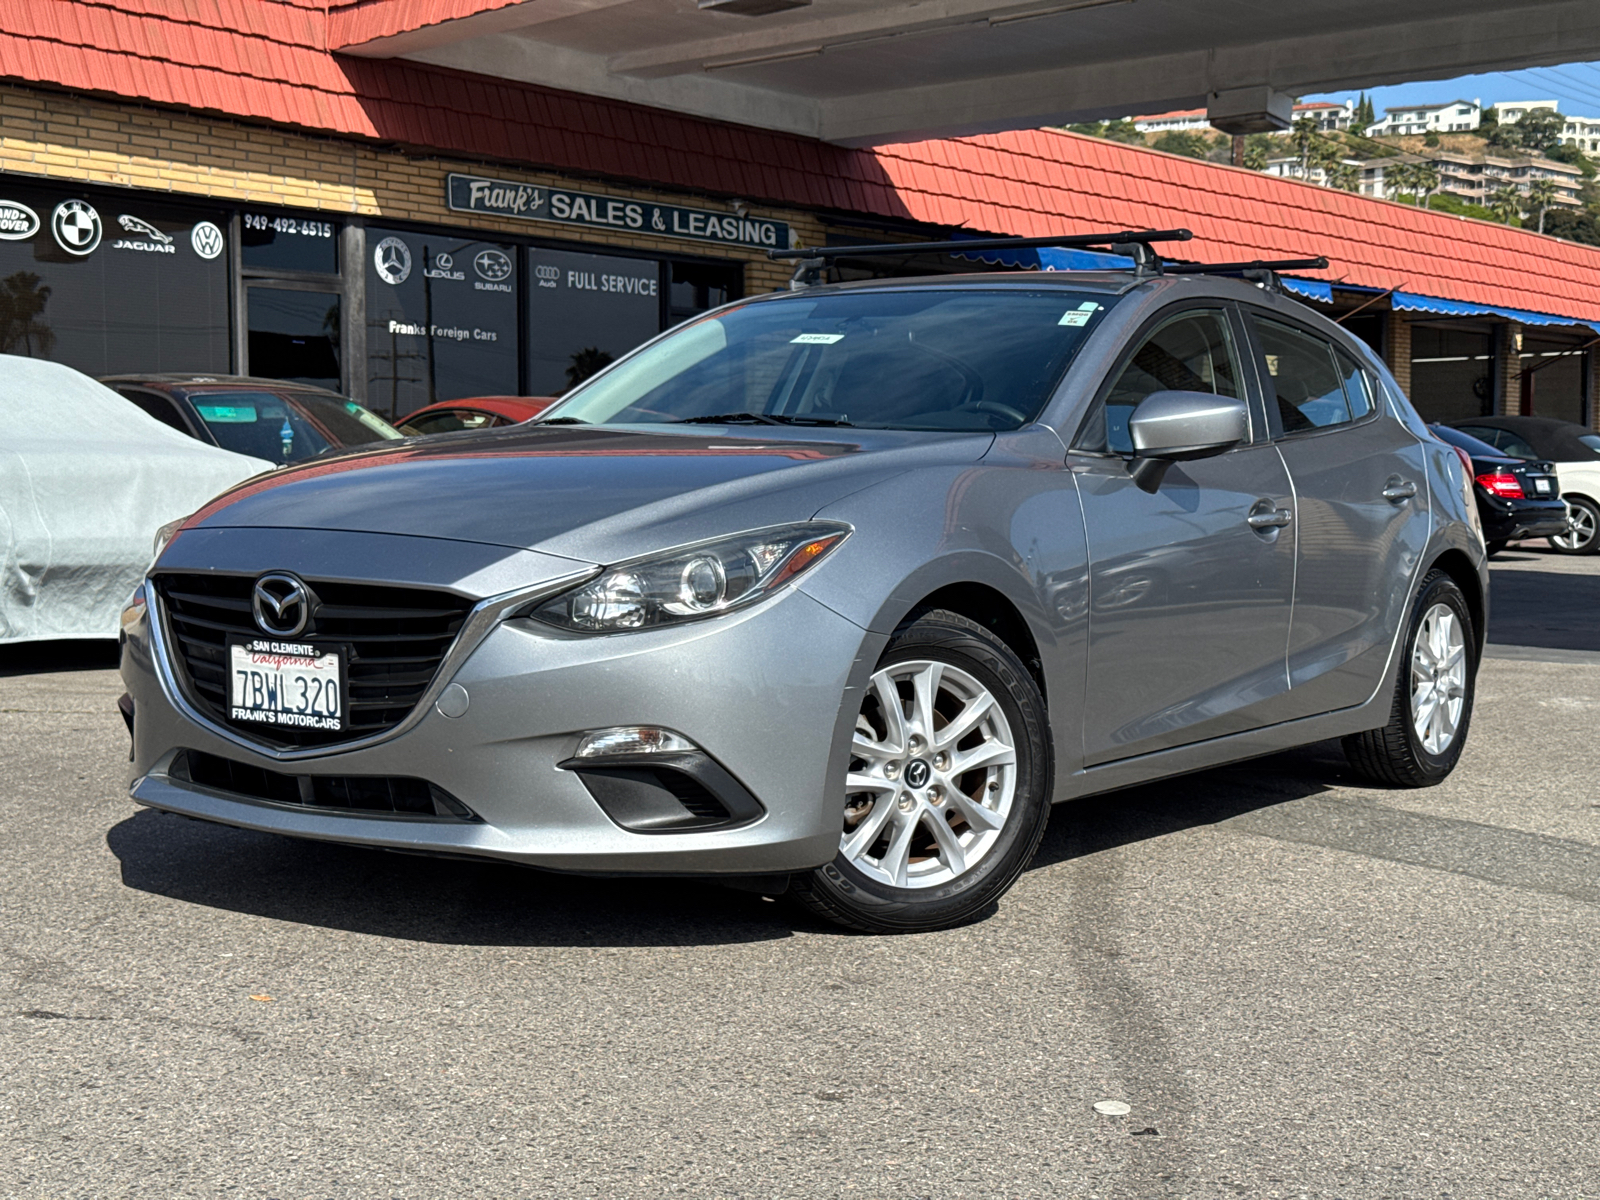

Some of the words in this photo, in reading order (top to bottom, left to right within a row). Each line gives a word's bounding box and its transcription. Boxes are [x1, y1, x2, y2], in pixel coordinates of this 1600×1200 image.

[469, 181, 544, 214] Frank's
[551, 194, 643, 228] SALES
[651, 207, 666, 232] &
[673, 210, 777, 245] LEASING
[0, 219, 29, 232] OVER
[244, 214, 331, 238] 949-492-6515
[112, 240, 176, 254] JAGUAR
[424, 268, 465, 280] LEXUS
[538, 279, 557, 288] Audi
[567, 271, 598, 291] FULL
[601, 274, 657, 296] SERVICE
[474, 281, 512, 293] SUBARU
[389, 320, 426, 336] Franks
[430, 324, 470, 341] Foreign
[473, 328, 498, 341] Cars
[252, 640, 270, 652] SAN
[271, 642, 314, 656] CLEMENTE
[252, 652, 324, 671] California
[236, 670, 339, 718] 7BWL320
[232, 707, 276, 722] FRANK'S
[277, 712, 341, 730] MOTORCARS
